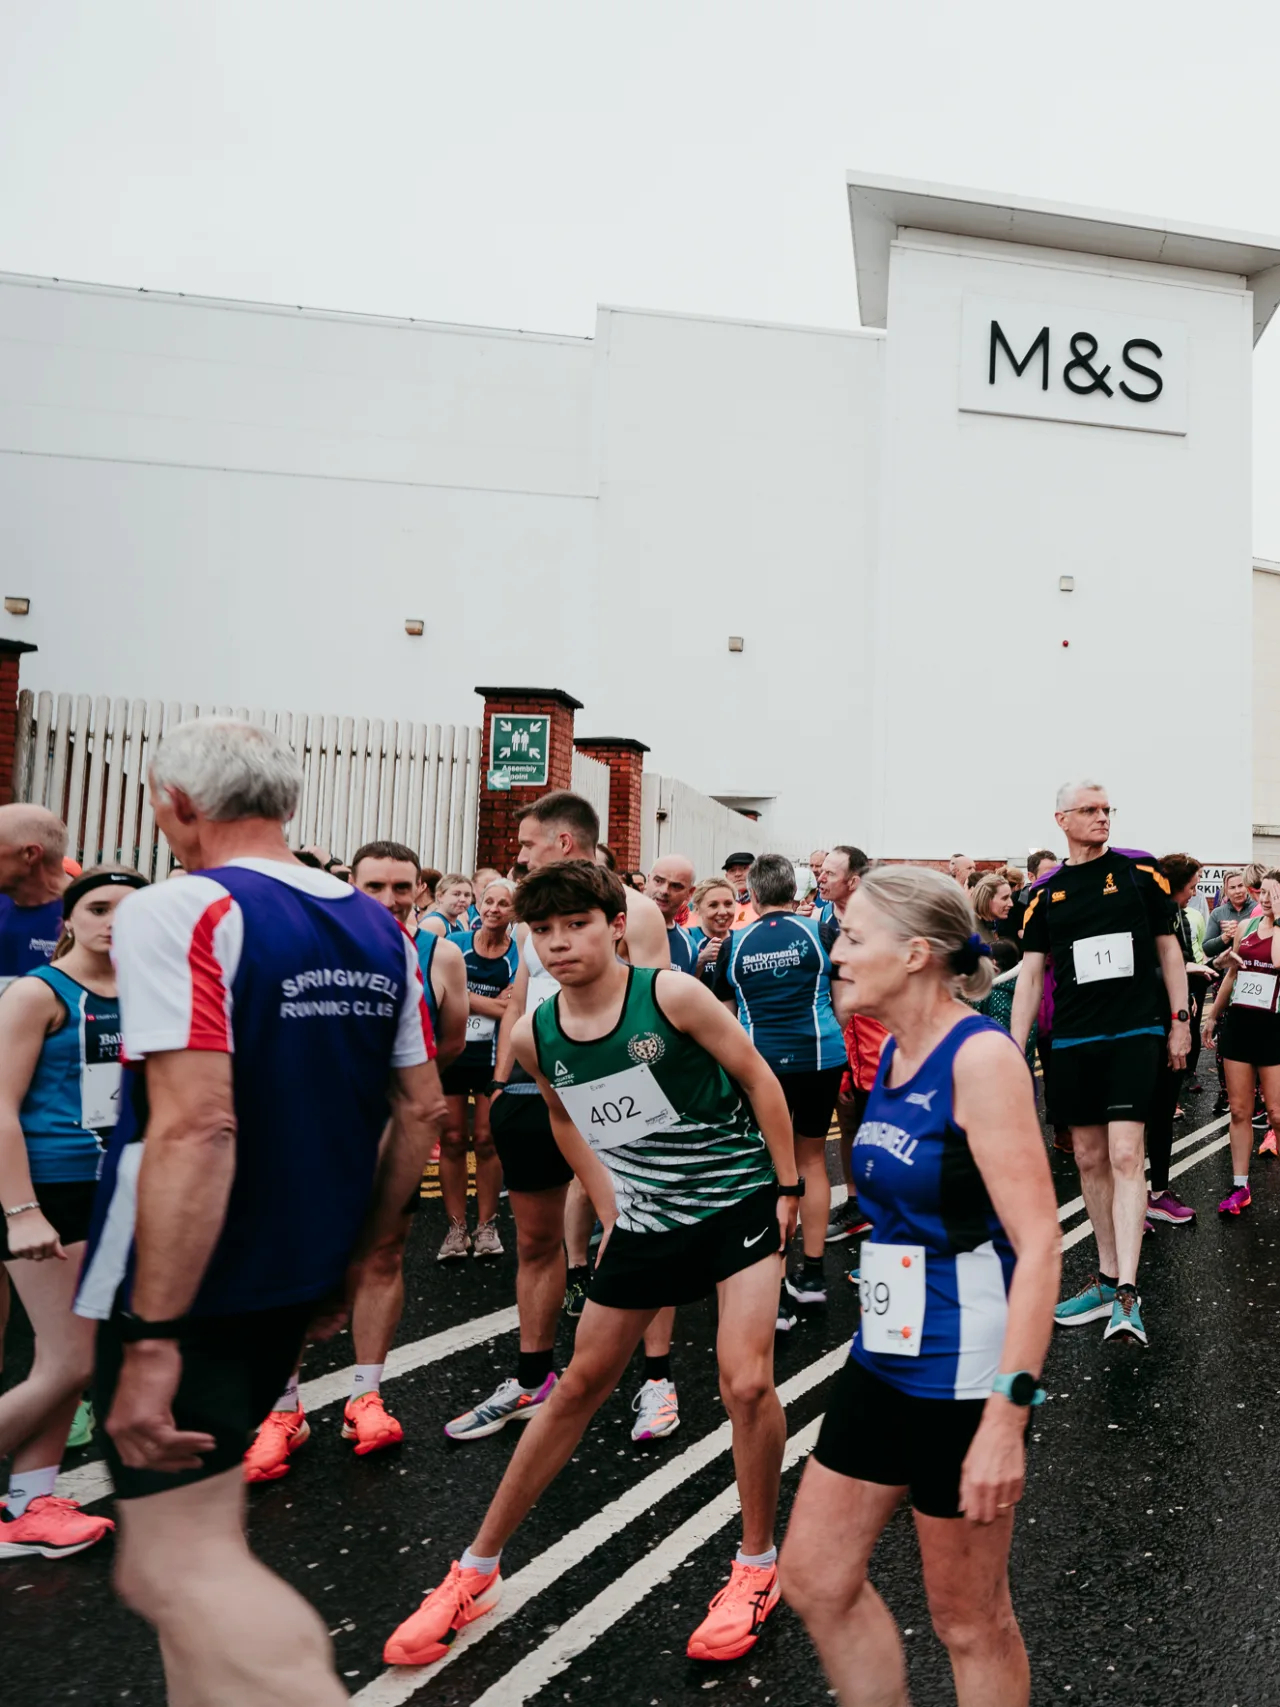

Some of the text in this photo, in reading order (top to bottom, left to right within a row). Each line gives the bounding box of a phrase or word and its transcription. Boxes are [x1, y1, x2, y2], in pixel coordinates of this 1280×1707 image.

[989, 320, 1163, 402] M&S
[501, 765, 537, 773] Assembly
[743, 949, 799, 965] Ballymena
[1094, 950, 1112, 965] 11
[743, 956, 800, 974] runners
[1240, 982, 1262, 996] 229
[589, 1083, 606, 1091] Evan
[591, 1096, 641, 1126] 402
